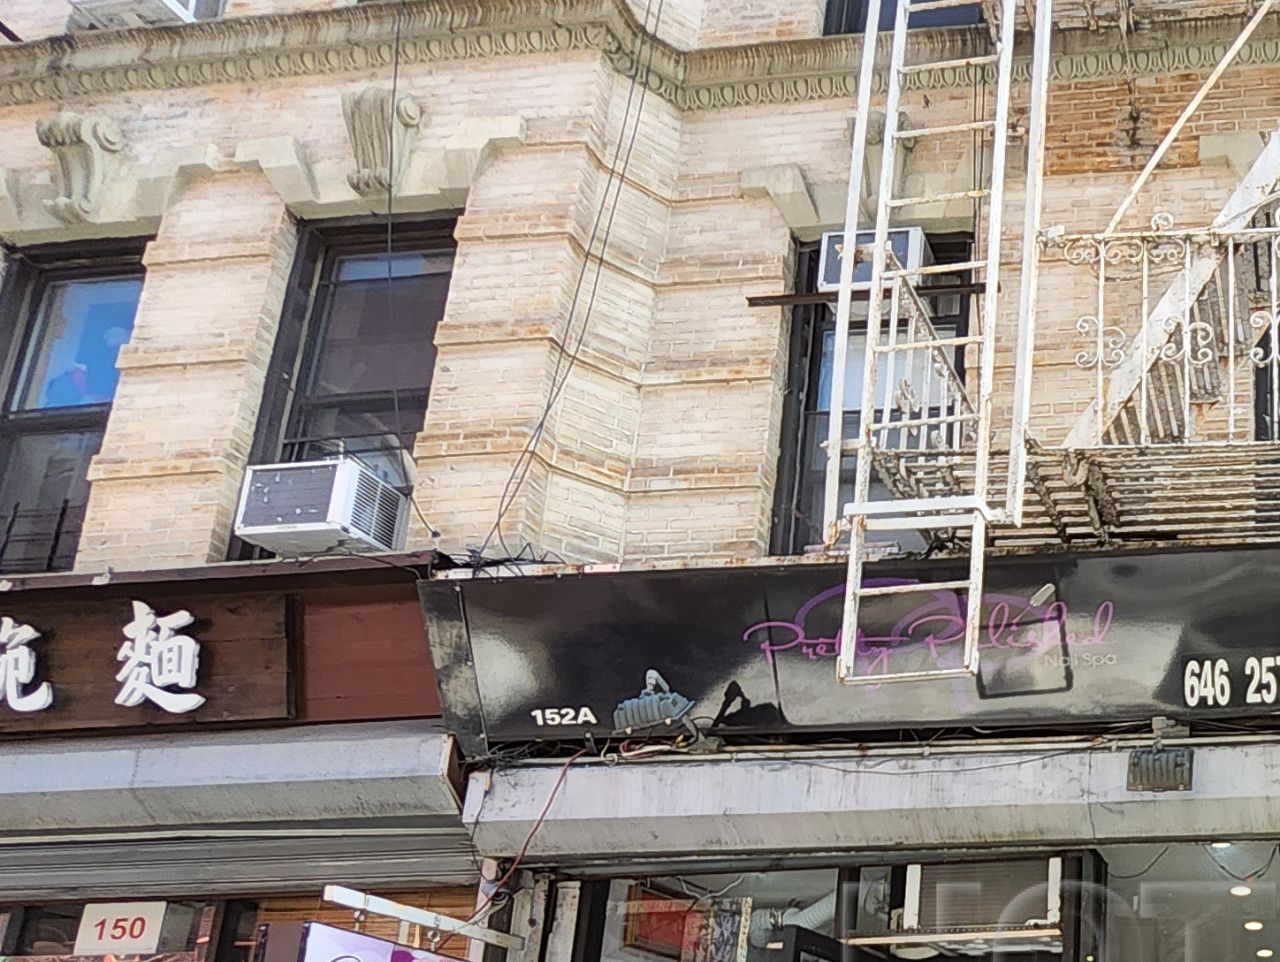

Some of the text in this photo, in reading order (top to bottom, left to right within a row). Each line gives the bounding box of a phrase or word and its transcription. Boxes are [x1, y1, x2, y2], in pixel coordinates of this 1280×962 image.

[908, 600, 1118, 657] Plished
[1044, 651, 1117, 668] Nail Spa
[1183, 657, 1231, 708] 646
[530, 707, 598, 727] 152A
[92, 916, 146, 942] 150
